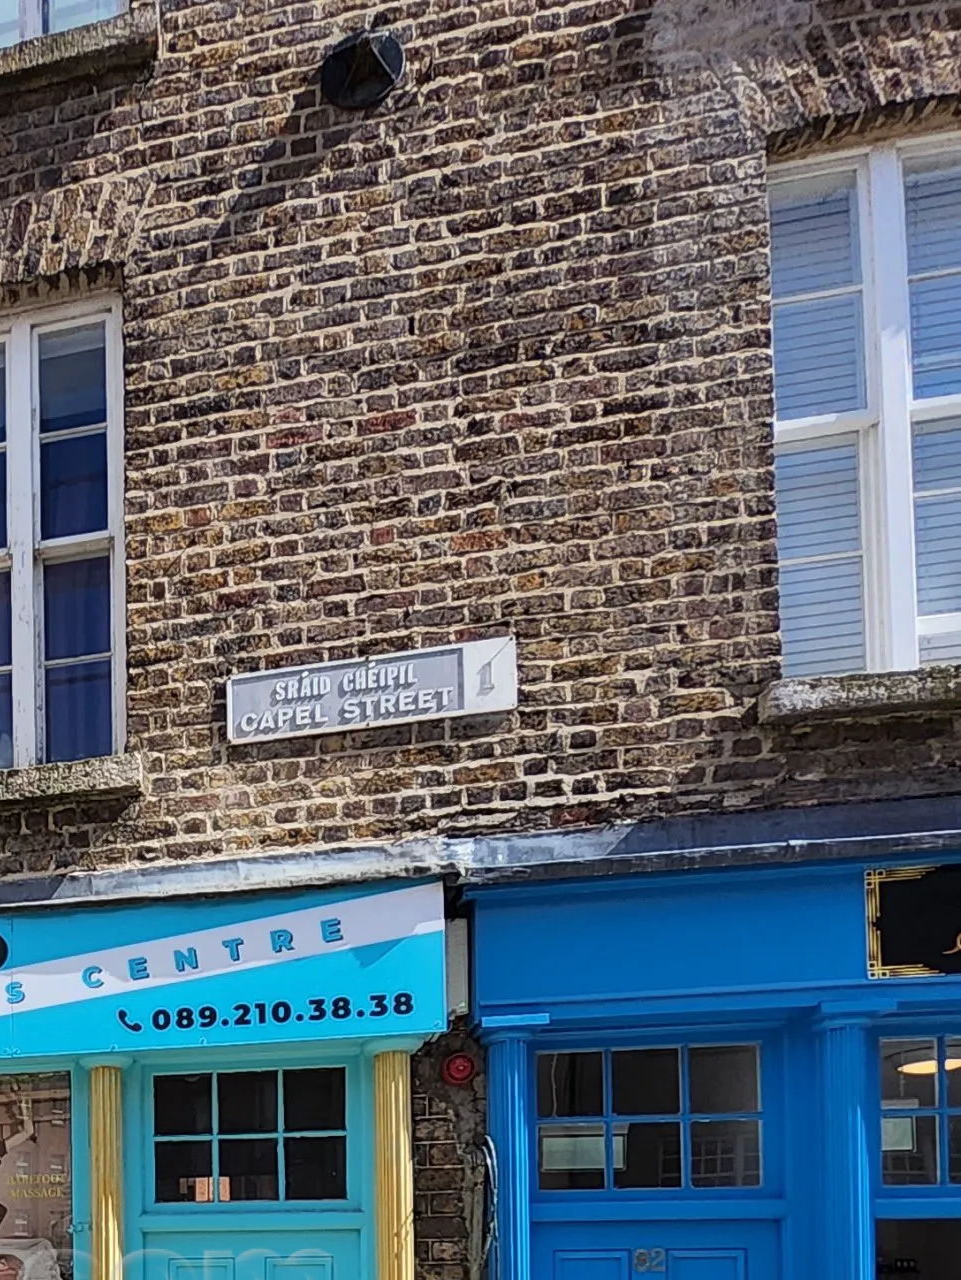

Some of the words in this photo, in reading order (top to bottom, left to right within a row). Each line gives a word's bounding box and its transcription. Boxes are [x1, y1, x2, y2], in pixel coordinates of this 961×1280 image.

[239, 705, 329, 733] CAPEL
[342, 686, 454, 720] STREET
[82, 918, 343, 989] CENTRE
[151, 992, 415, 1031] 089.210.38.38
